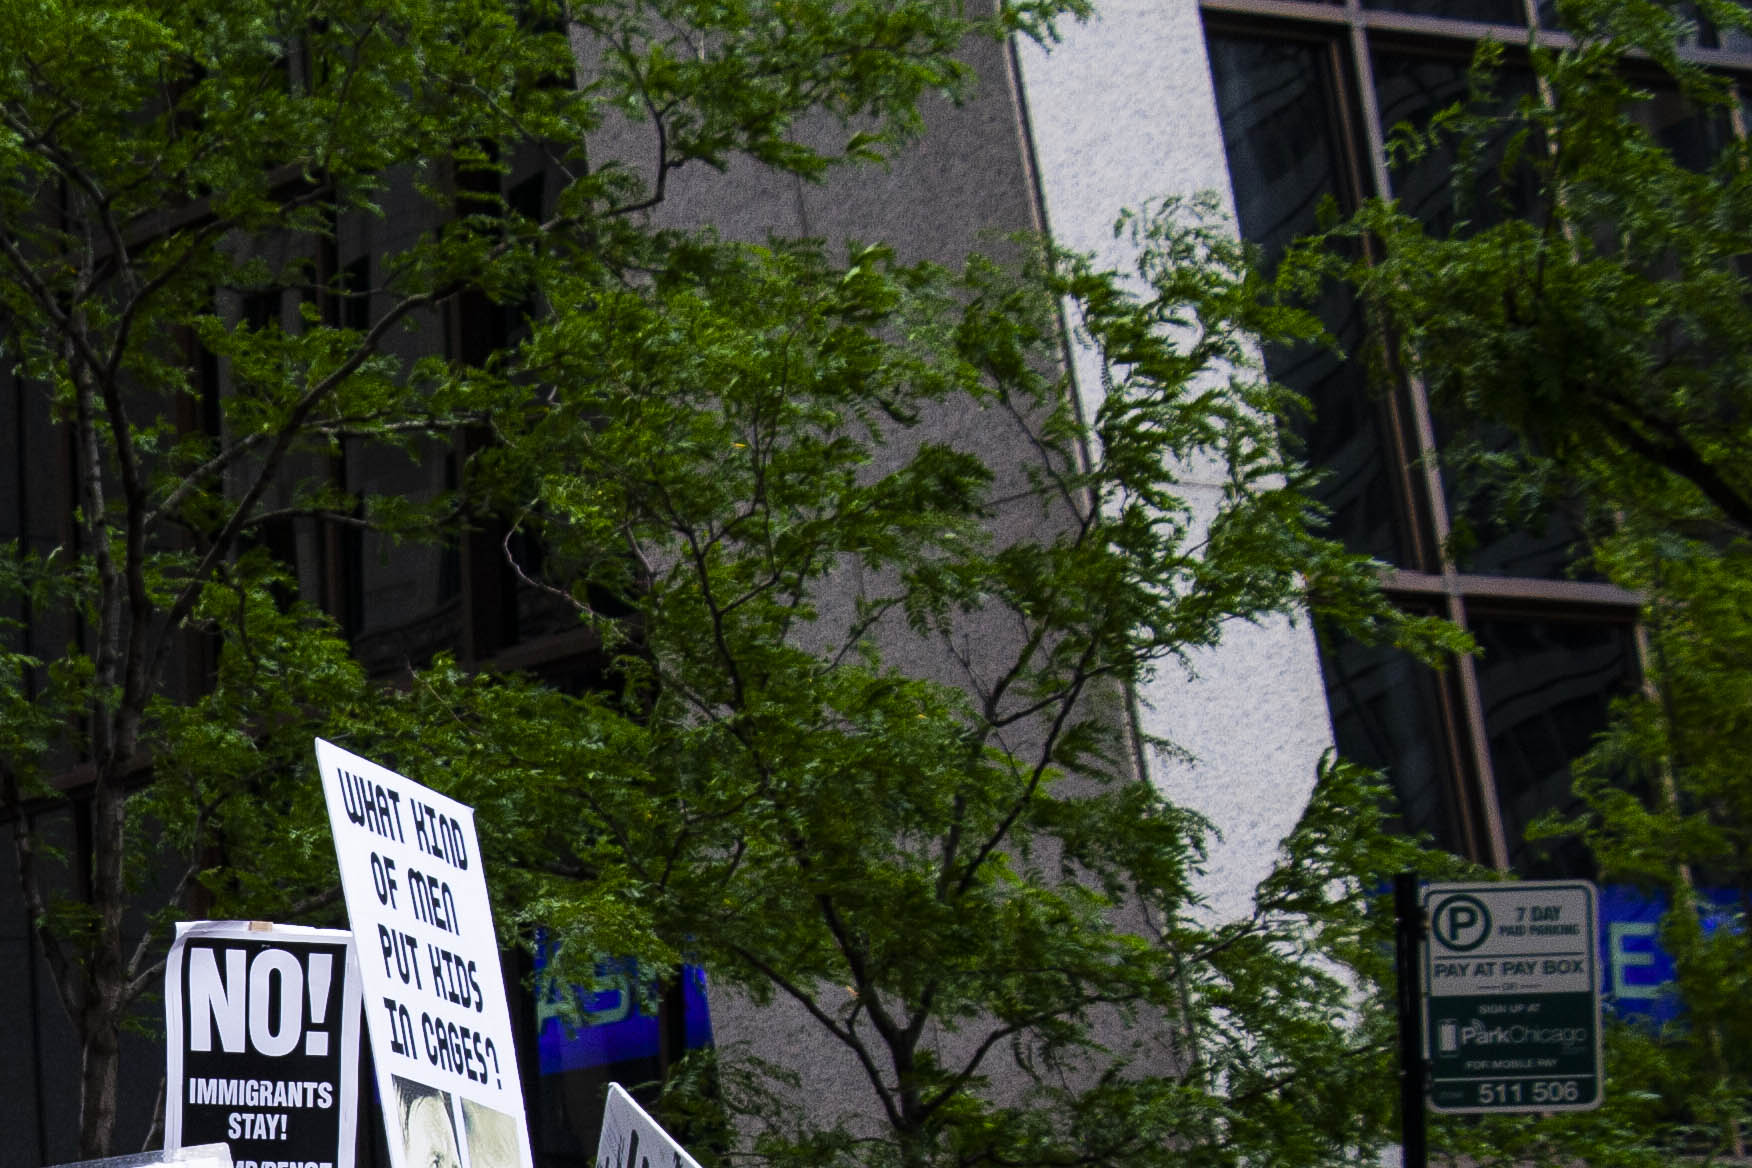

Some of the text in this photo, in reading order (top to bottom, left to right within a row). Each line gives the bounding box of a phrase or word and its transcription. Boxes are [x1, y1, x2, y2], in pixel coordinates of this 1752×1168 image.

[337, 767, 468, 871] WHAT KIND
[370, 851, 460, 936] OF MEN
[1530, 905, 1563, 922] DAY
[377, 923, 484, 1013] PUT KIDS
[1433, 958, 1585, 978] PAY AT PAY BOX
[189, 947, 334, 1057] NO!
[382, 996, 503, 1090] IN CAGES?
[189, 1077, 333, 1108] IMMIGRANTS
[1479, 1082, 1523, 1104] 511
[1533, 1080, 1580, 1102] 506
[228, 1112, 288, 1140] STAY!
